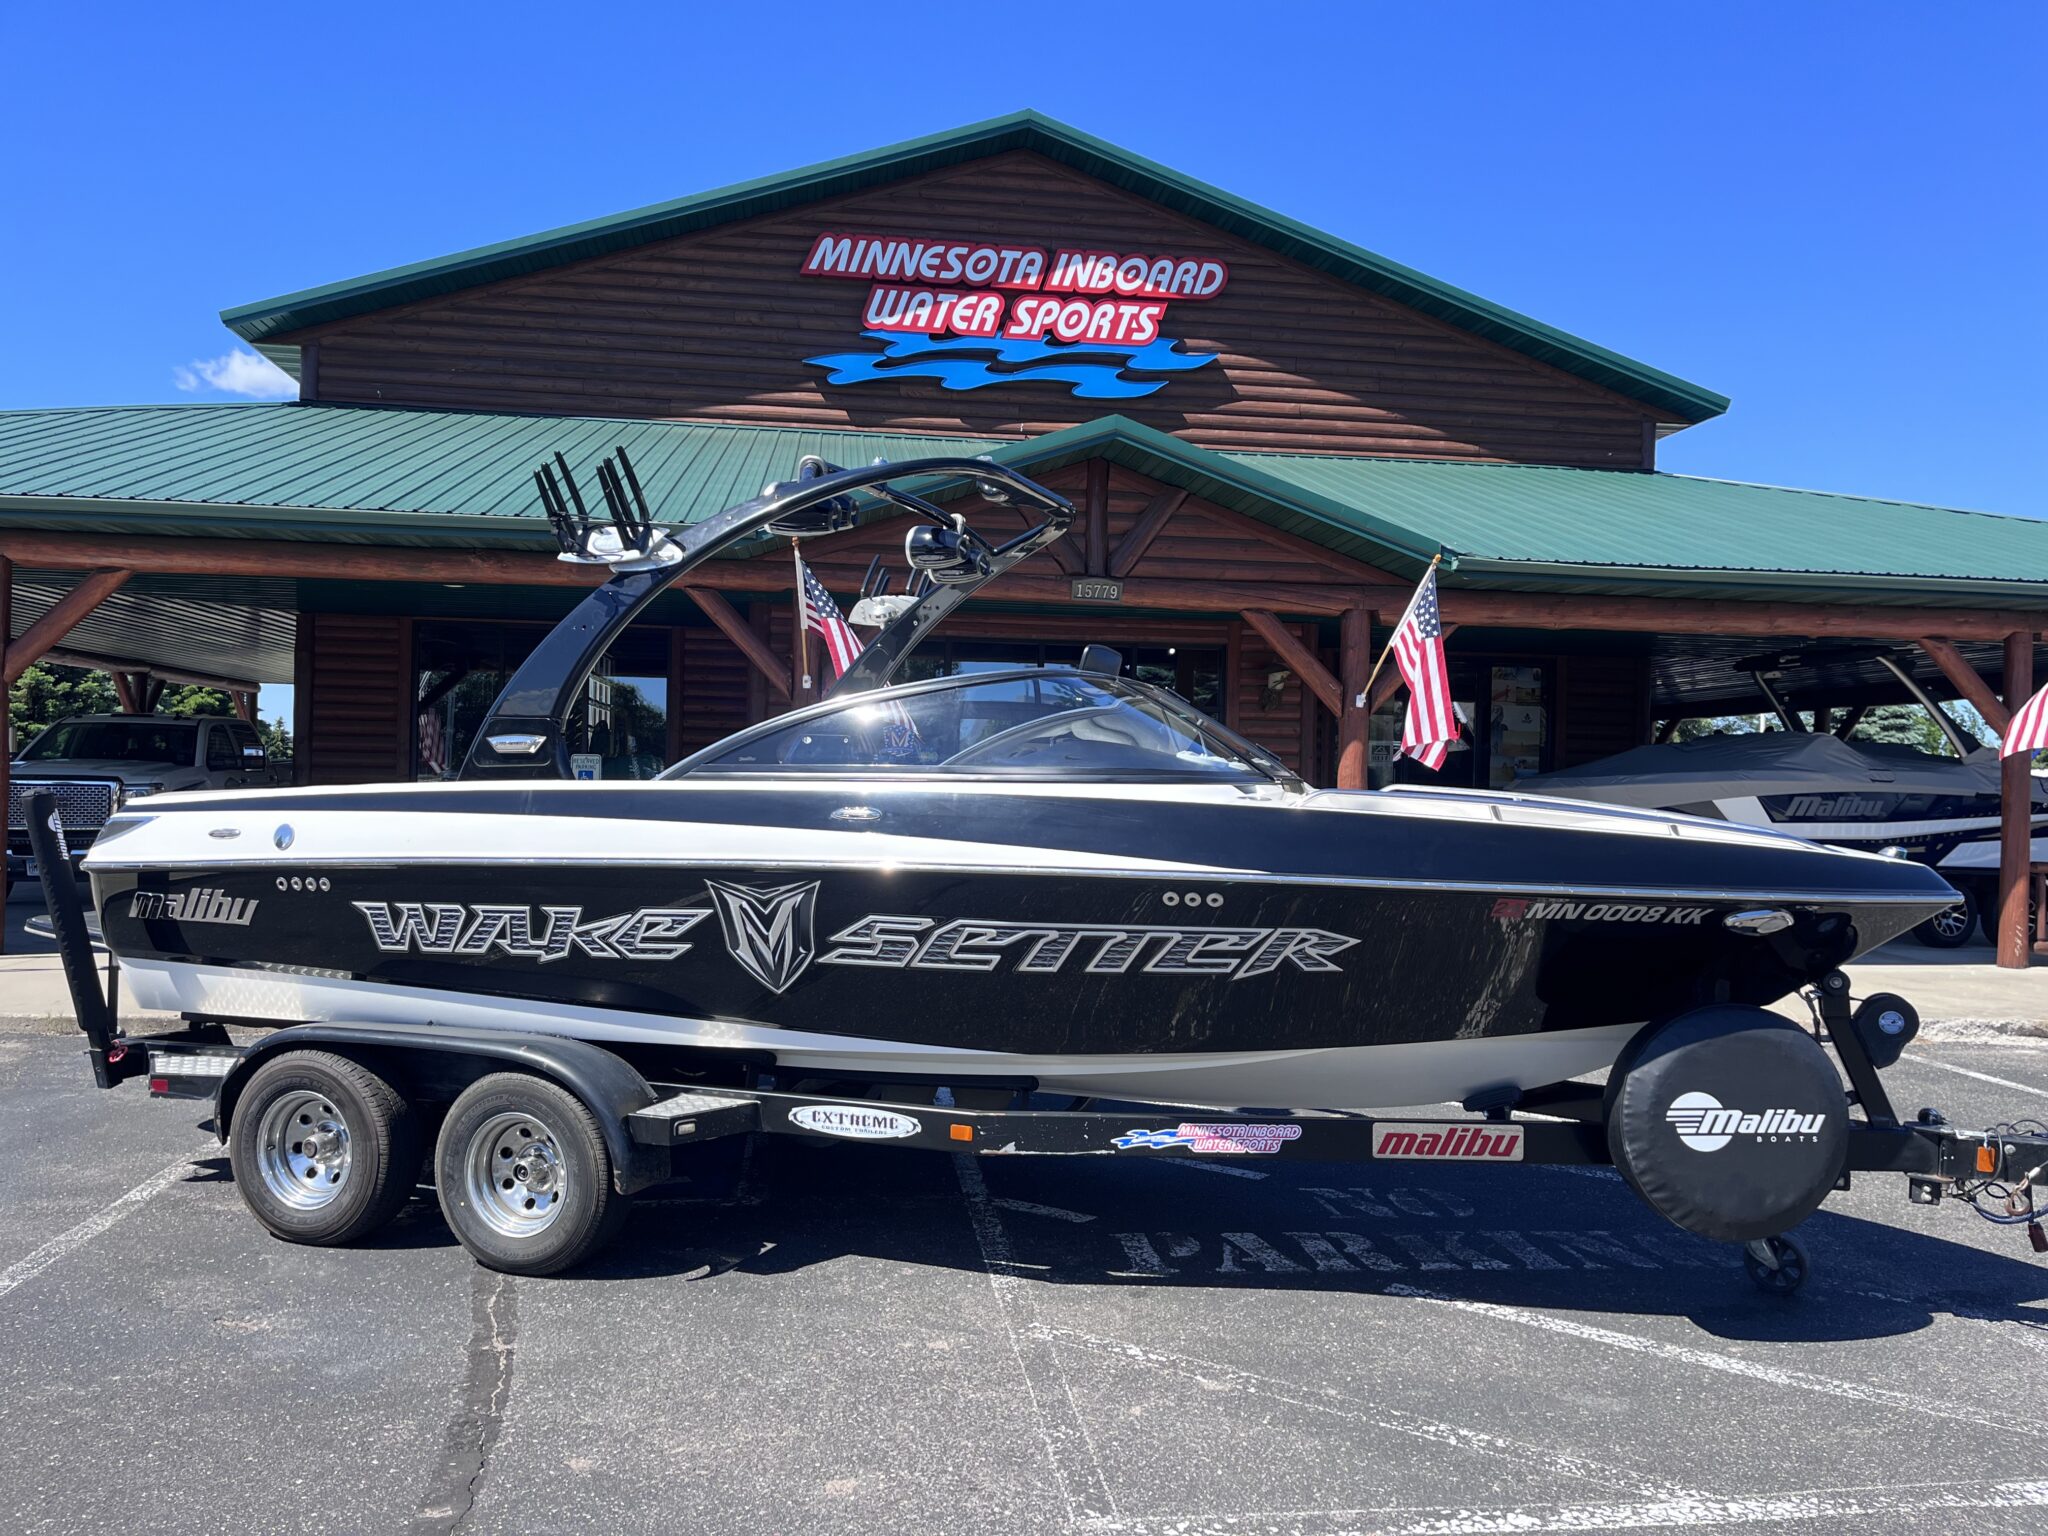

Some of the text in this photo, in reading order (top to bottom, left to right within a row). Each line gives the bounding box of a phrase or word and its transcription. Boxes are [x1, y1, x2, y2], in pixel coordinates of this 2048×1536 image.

[808, 236, 1224, 296] MINNESOTA INBOARD
[866, 287, 1161, 343] WATER SPORTS
[1076, 584, 1118, 599] 15779
[1525, 902, 1587, 919] MN
[1583, 903, 1662, 922] 0008
[1662, 907, 1715, 925] KK
[351, 901, 714, 963] WAKE
[815, 915, 1363, 981] SETTER
[811, 1110, 899, 1130] EXTREME
[1178, 1124, 1301, 1139] MINNESOTA INBOARD
[1756, 1135, 1819, 1143] BOATS
[1194, 1138, 1280, 1152] WATER SPORTS
[1300, 1187, 1476, 1220] NO
